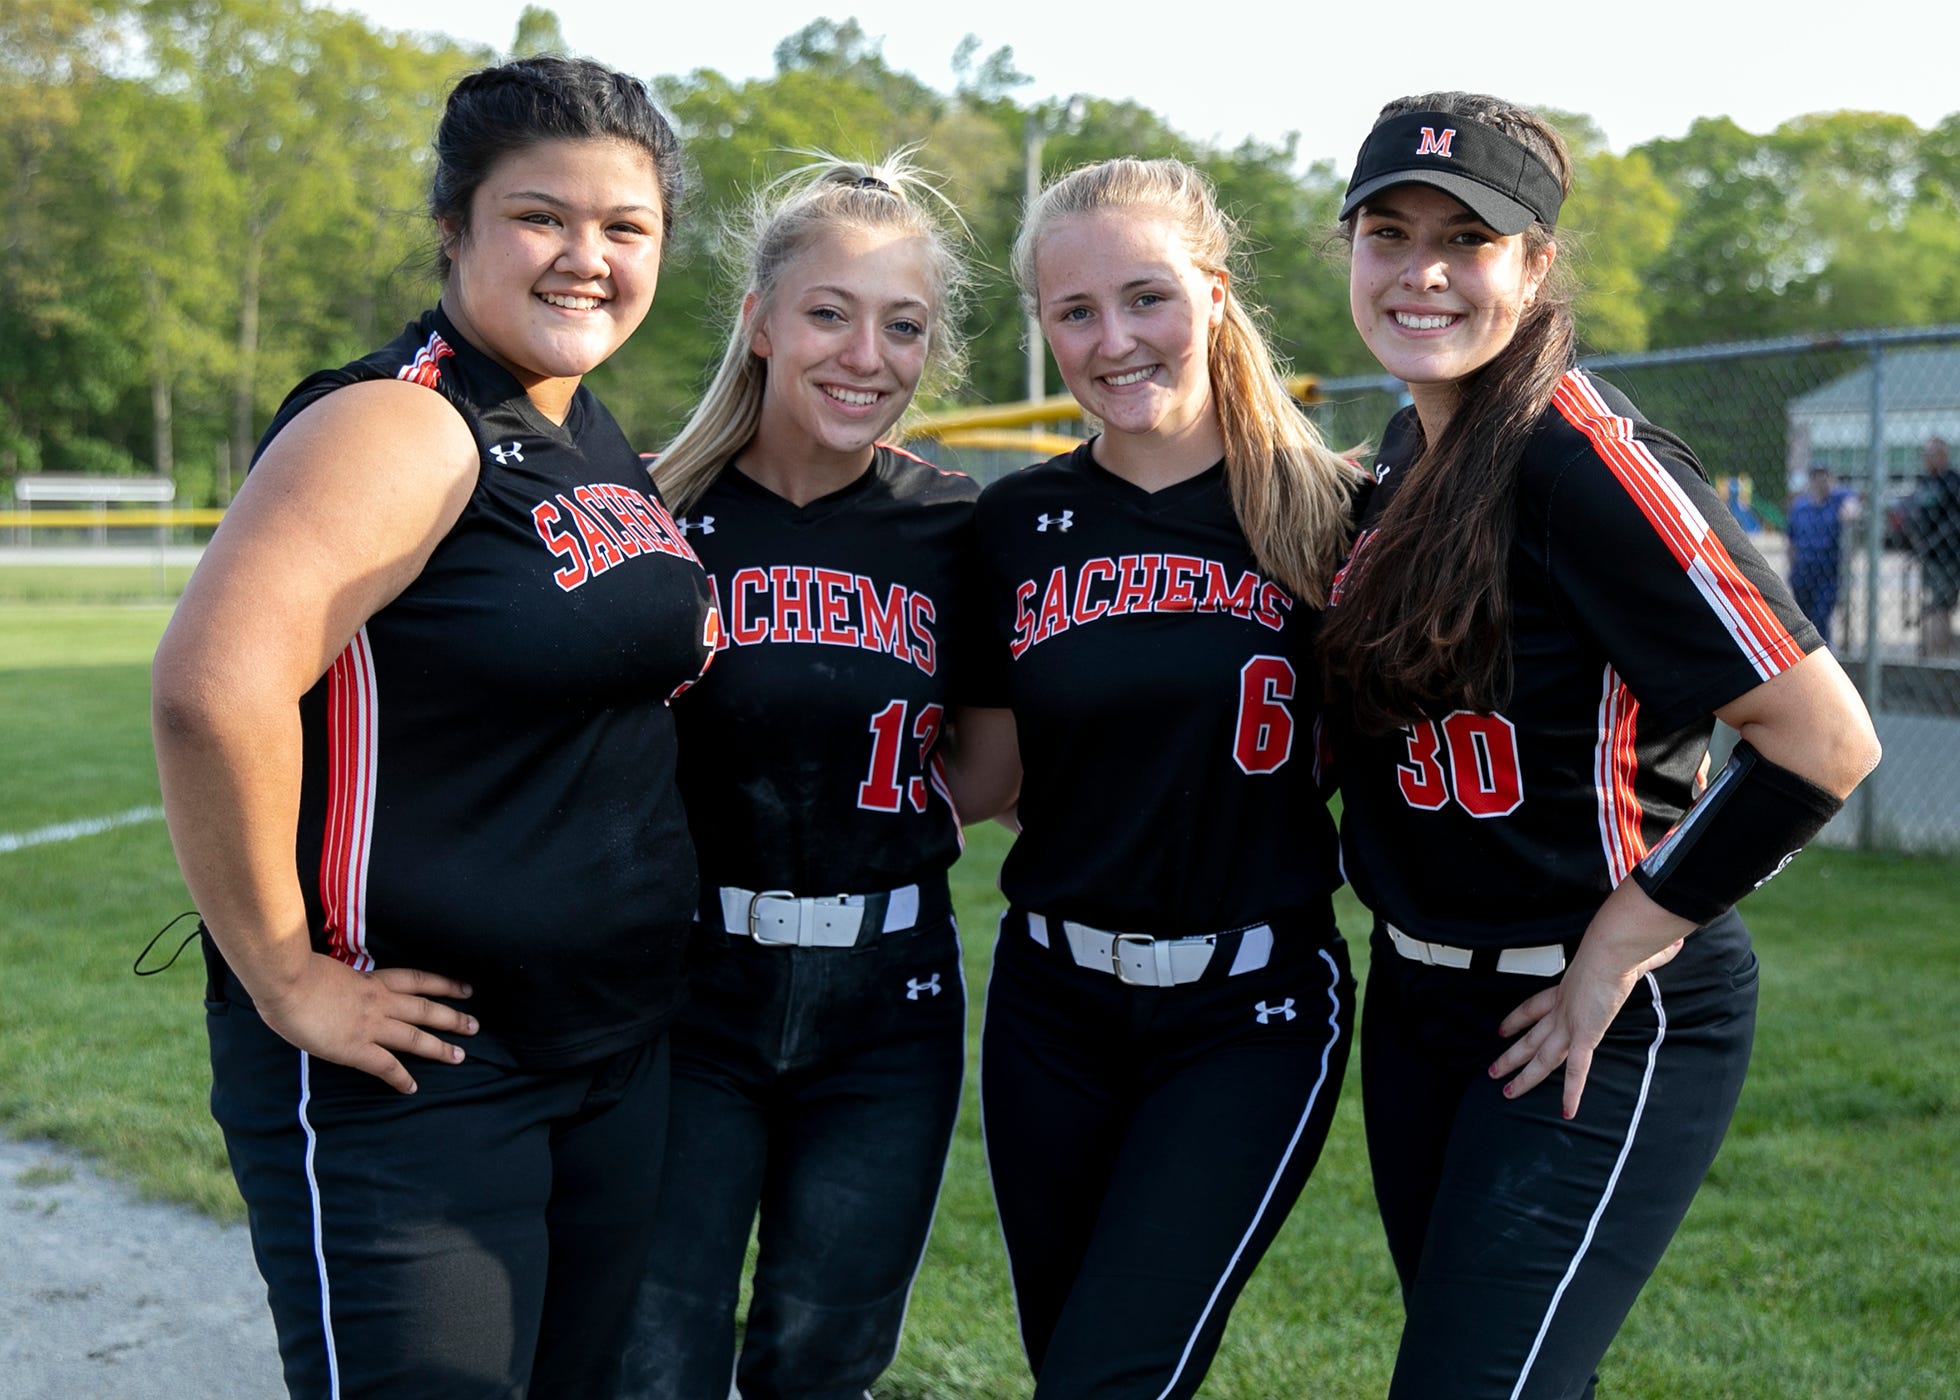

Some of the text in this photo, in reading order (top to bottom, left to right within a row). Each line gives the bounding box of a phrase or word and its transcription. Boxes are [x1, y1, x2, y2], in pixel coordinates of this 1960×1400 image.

[1416, 127, 1456, 157] M
[531, 483, 704, 592] SACHEM
[707, 566, 936, 676] CHEMS
[1009, 554, 1293, 661] SACHEMS
[1233, 654, 1296, 775] 6
[1397, 704, 1524, 819] 30
